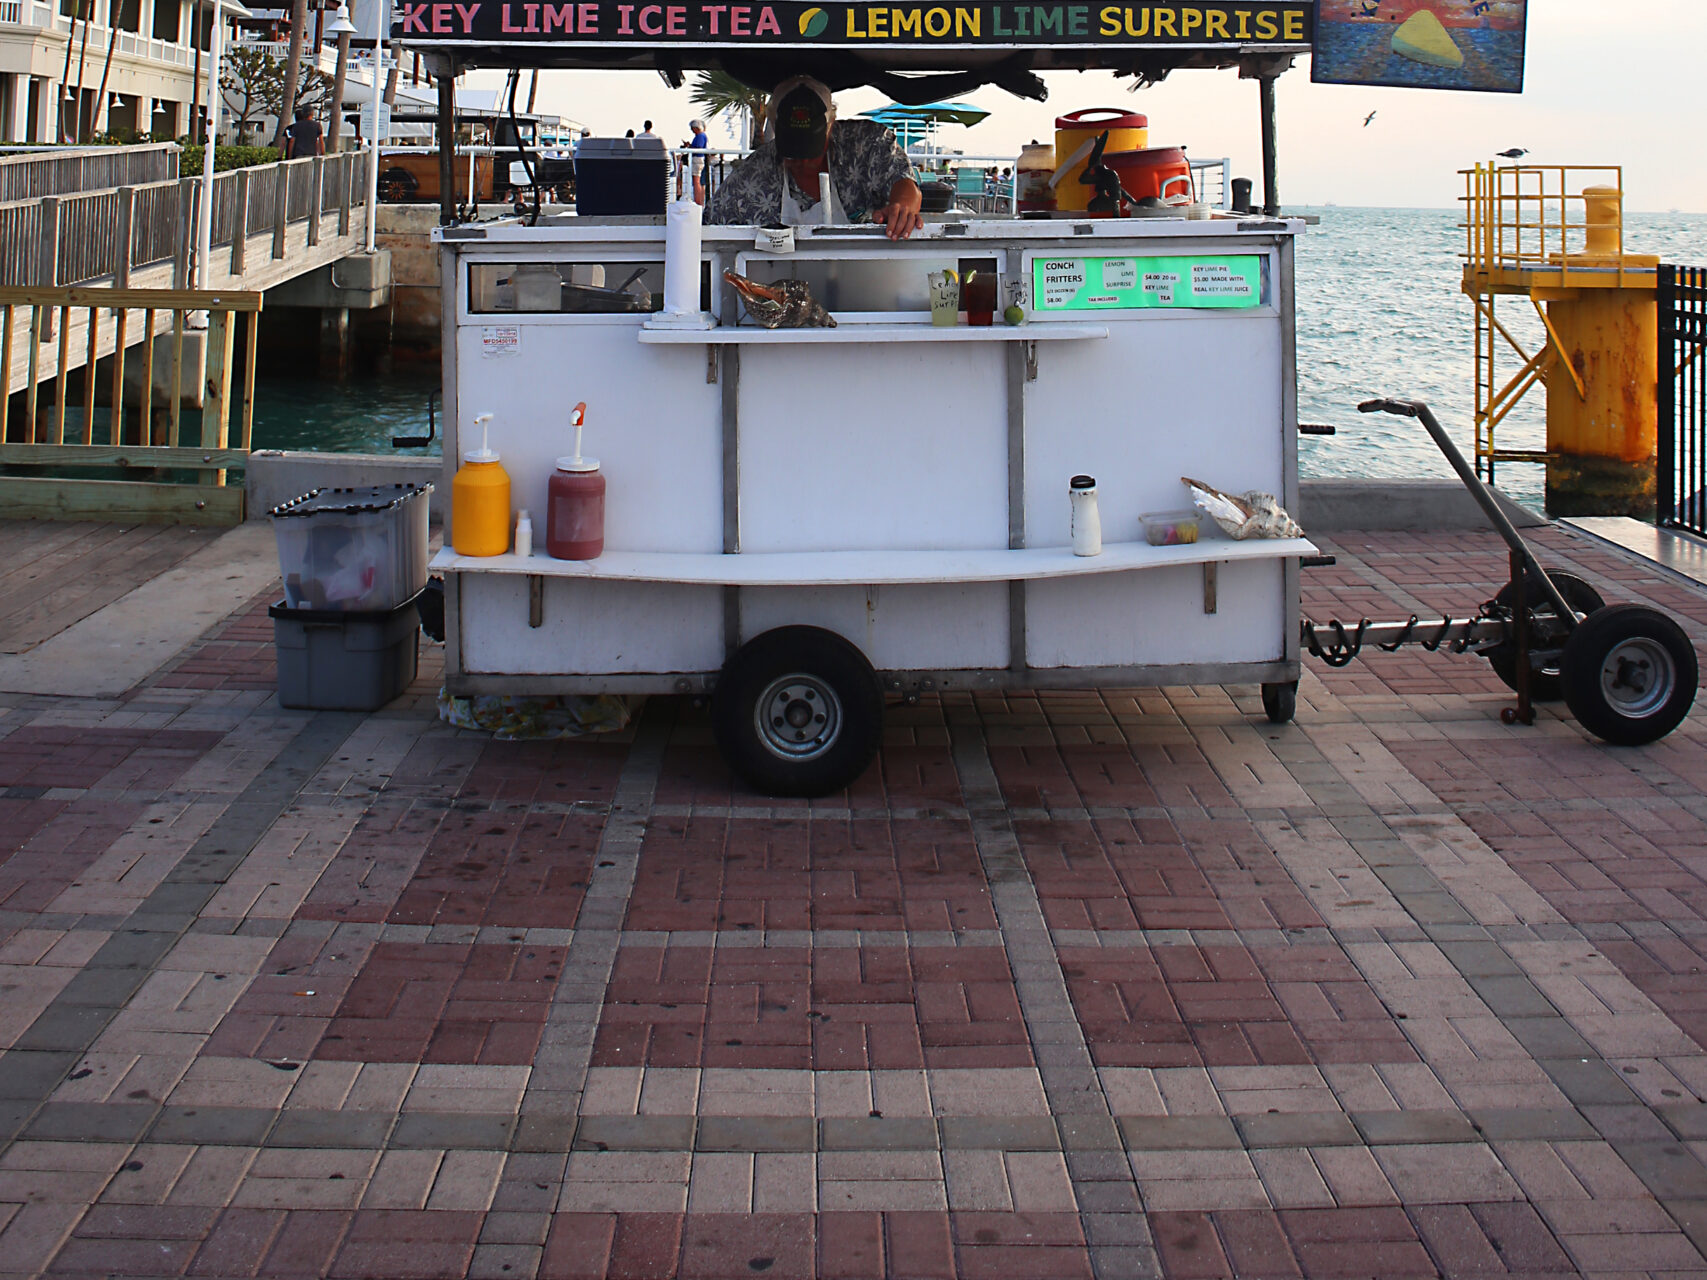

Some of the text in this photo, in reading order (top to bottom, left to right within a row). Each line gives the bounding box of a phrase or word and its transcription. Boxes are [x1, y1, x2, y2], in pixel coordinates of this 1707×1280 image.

[403, 3, 782, 36] KEY LIME ICE TEA
[846, 6, 1305, 40] LEMON LIME SURPRISE
[1046, 261, 1074, 270] CONCH
[1046, 275, 1082, 283] FRITTERS
